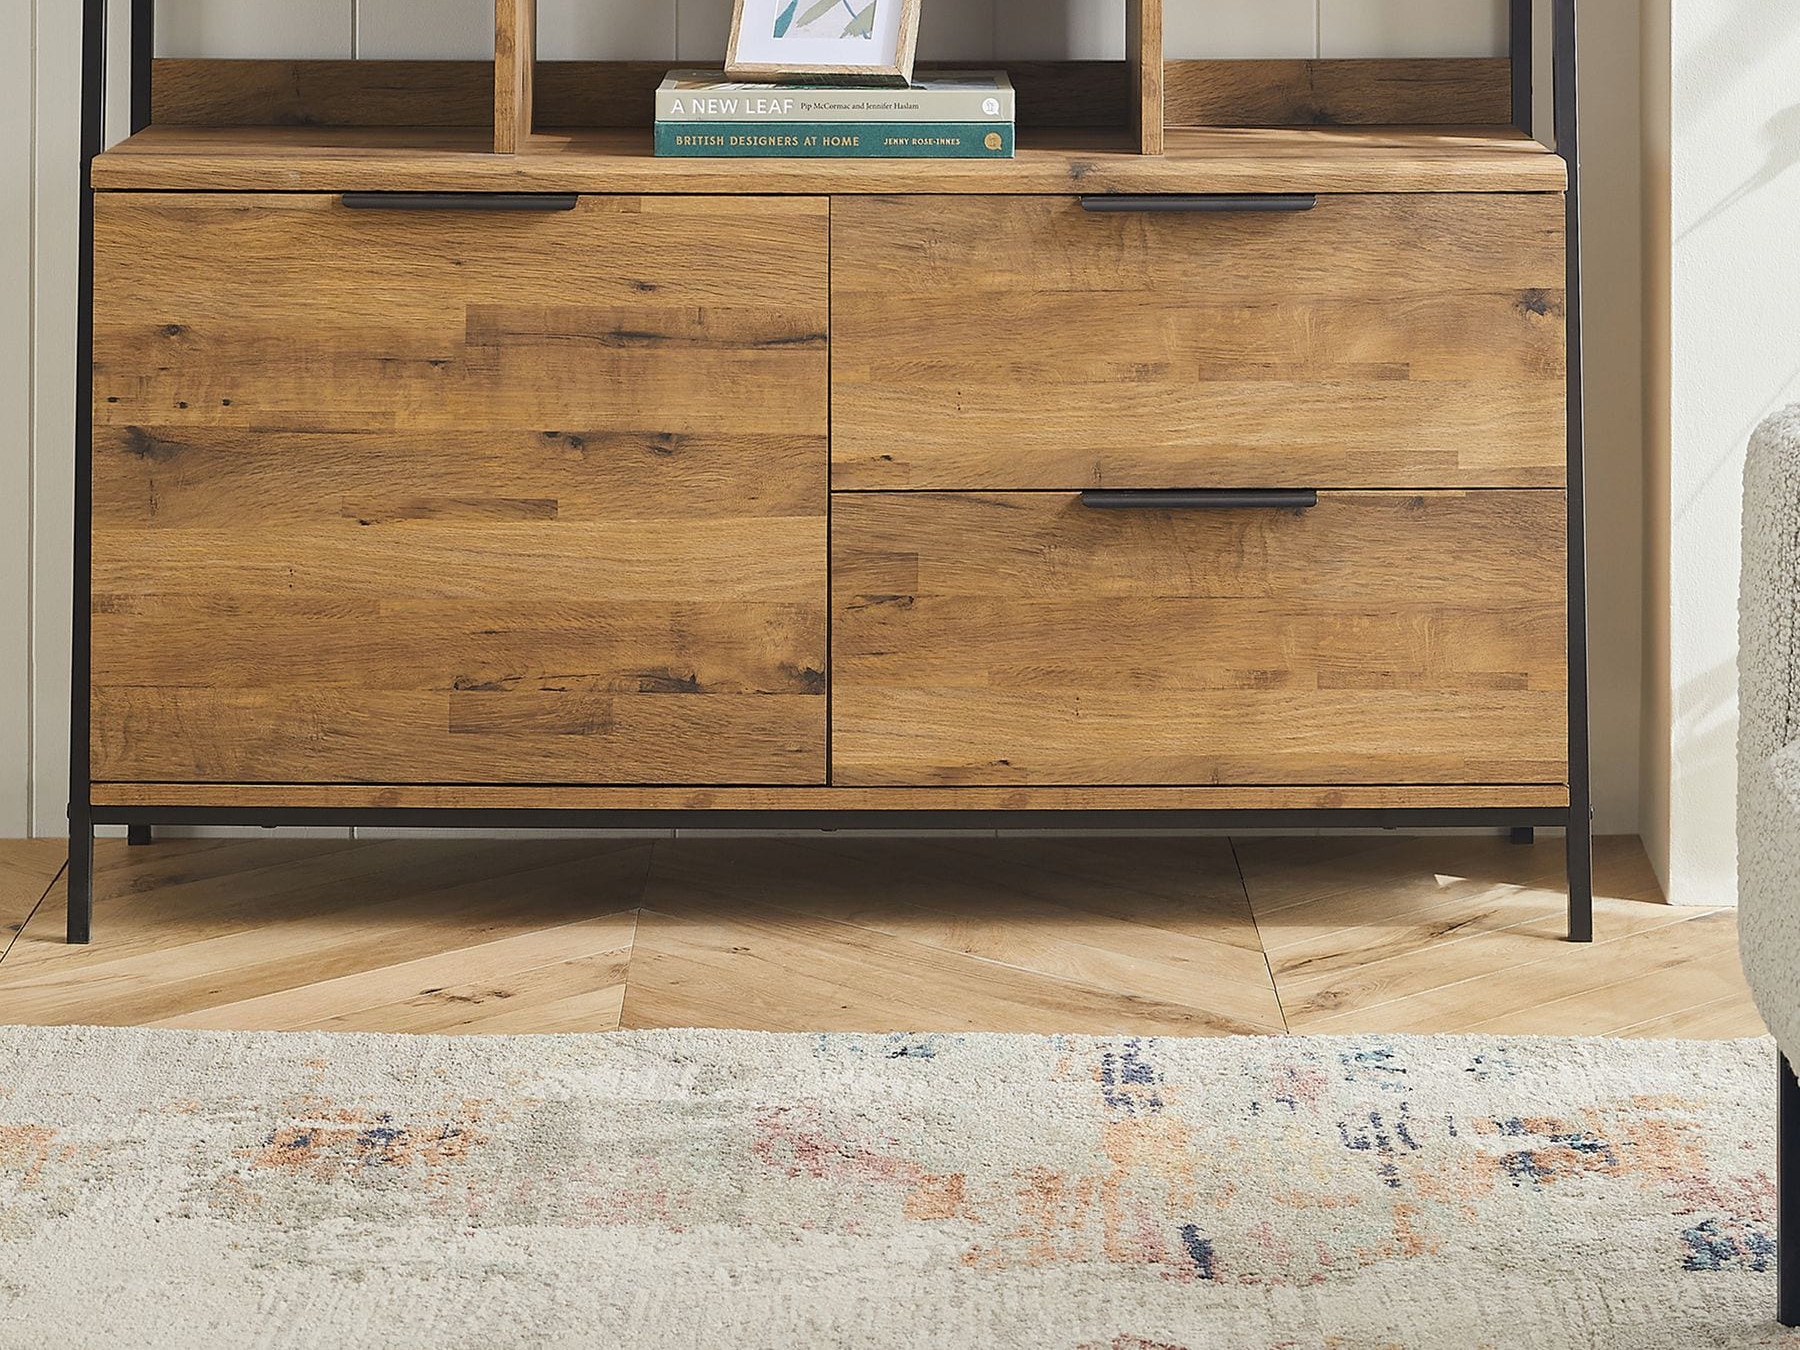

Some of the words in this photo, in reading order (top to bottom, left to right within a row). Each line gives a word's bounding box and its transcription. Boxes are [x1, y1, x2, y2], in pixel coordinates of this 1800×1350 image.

[670, 99, 685, 114] A
[692, 99, 739, 114] NEW
[746, 99, 794, 114] LEAF
[800, 102, 812, 110] Pip
[814, 102, 850, 110] McCormac
[852, 102, 865, 110] and
[866, 102, 893, 111] Jennifer
[894, 102, 920, 110] Haslam
[676, 136, 724, 146] BRITISH
[730, 136, 799, 146] DESIGNERS
[804, 136, 816, 146] AT
[822, 136, 860, 146] HOME
[883, 137, 910, 146] JENNY
